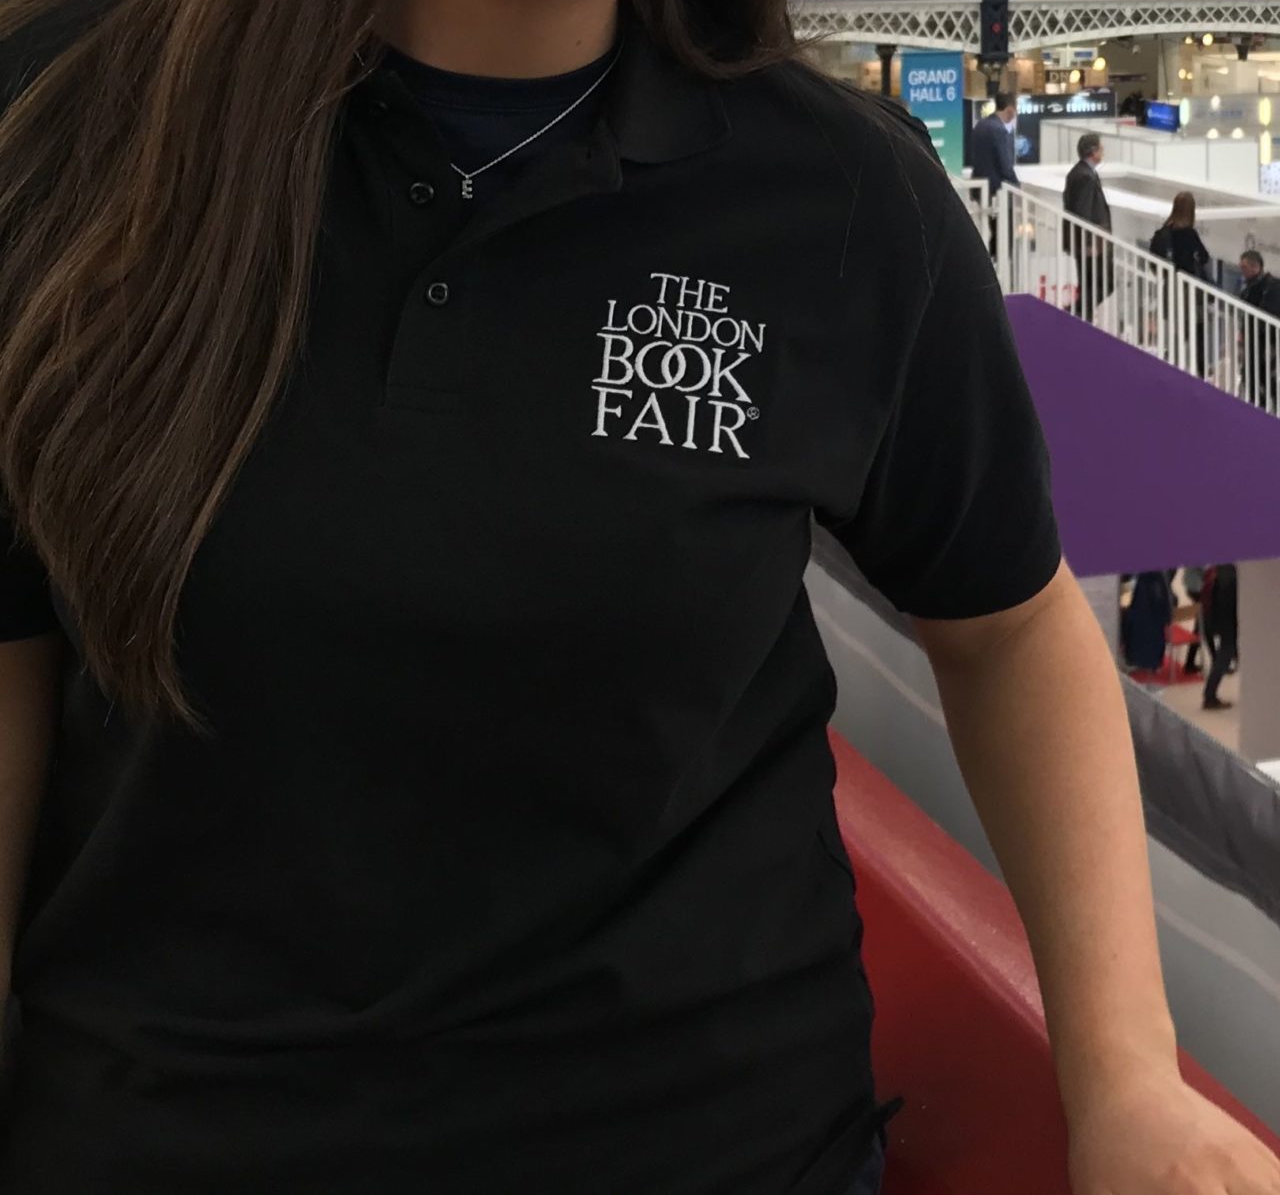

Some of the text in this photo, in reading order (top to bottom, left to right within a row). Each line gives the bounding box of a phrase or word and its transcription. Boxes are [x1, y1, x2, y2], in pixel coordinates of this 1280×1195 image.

[908, 69, 957, 86] GRAND
[910, 87, 956, 102] HALL 6
[650, 273, 730, 313] THE
[602, 300, 766, 353] LONDON
[593, 333, 752, 404] BOOK
